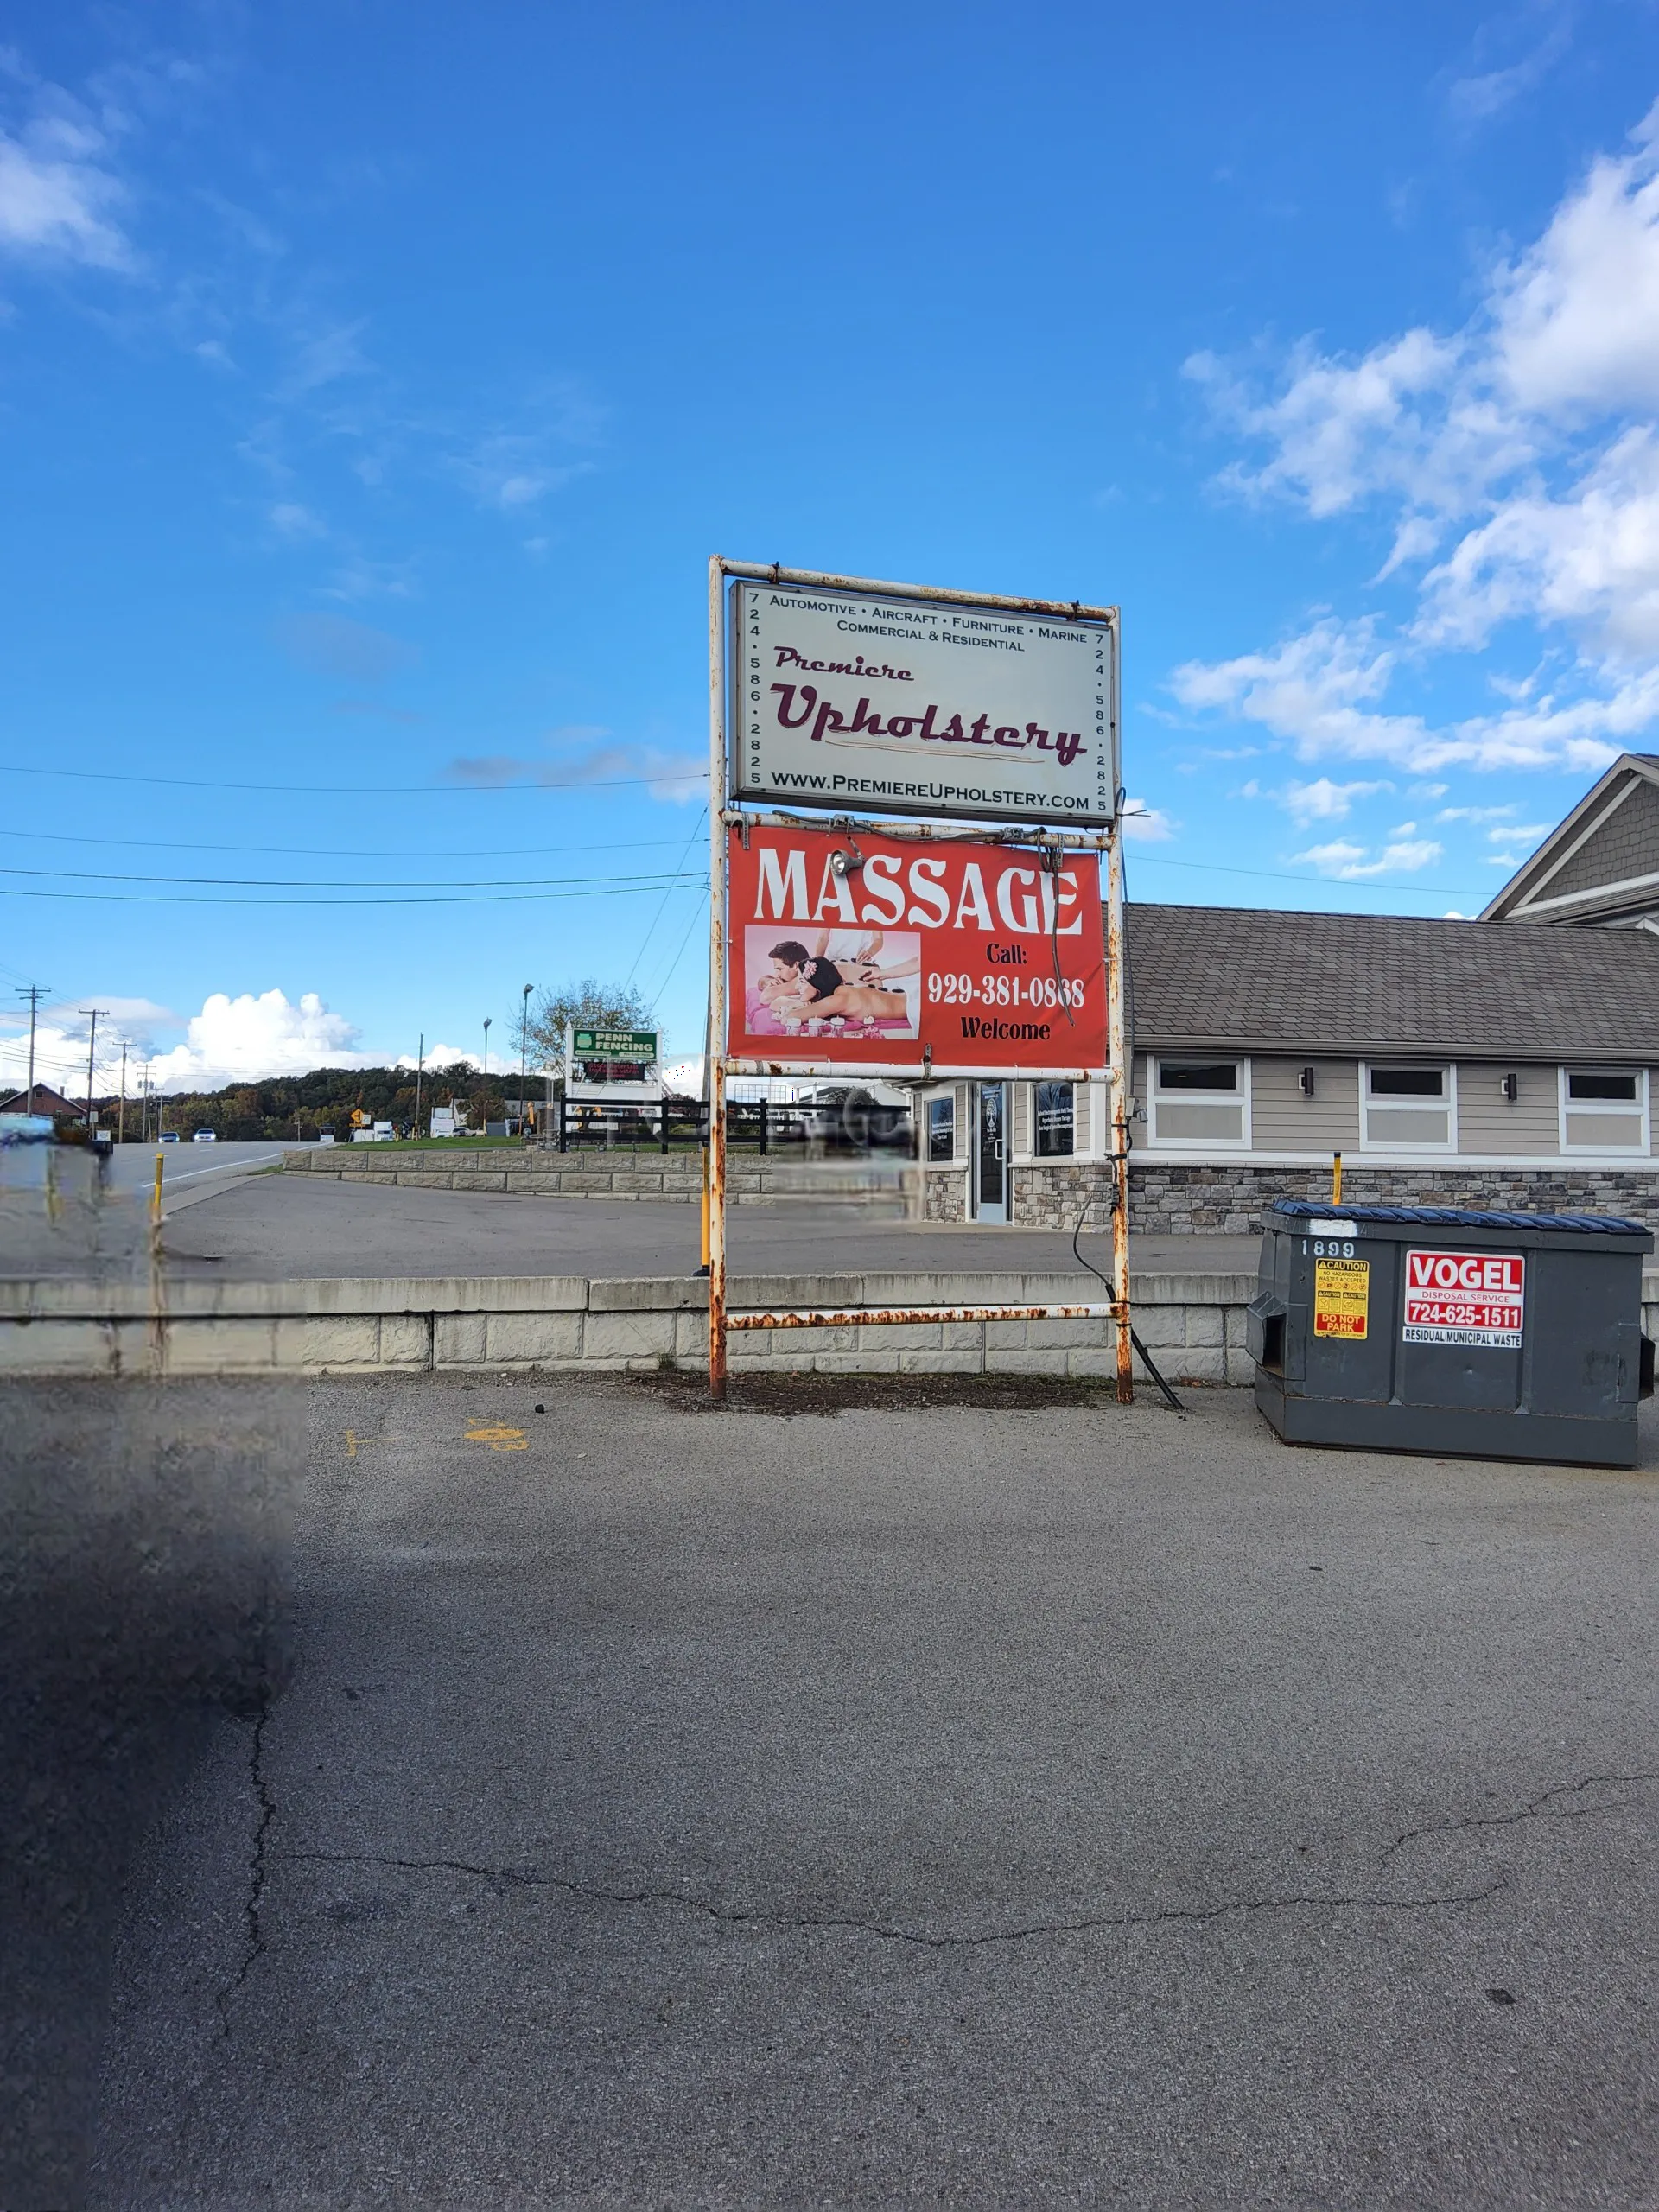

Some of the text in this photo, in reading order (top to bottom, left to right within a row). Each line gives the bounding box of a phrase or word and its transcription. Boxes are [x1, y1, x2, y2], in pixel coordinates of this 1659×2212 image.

[769, 594, 1088, 644] AUTOMOTIVE AIRCRAFT FURNITURE MARINE
[836, 620, 1026, 652] COMMERCIAL & RESIDENTIAL
[773, 645, 915, 682] Premiere
[769, 683, 1088, 767] Upholstery
[753, 848, 1083, 936] MASSAGE
[986, 943, 1028, 965] Call:
[595, 1033, 633, 1042] PENN
[960, 1016, 1051, 1040] Welcome
[595, 1041, 654, 1052] FENCING
[1302, 1239, 1355, 1258] 1899
[1326, 1262, 1367, 1271] CAUTION
[1412, 1256, 1521, 1291] VOGEL
[1421, 1291, 1510, 1303] DISPOSAL SERVICE
[1321, 1314, 1361, 1325] DO NOT
[1410, 1302, 1519, 1327] 724-625-1511
[1326, 1322, 1355, 1332] PARK
[1405, 1328, 1521, 1347] RESIDUAL/MUNICIPAL WASTE
